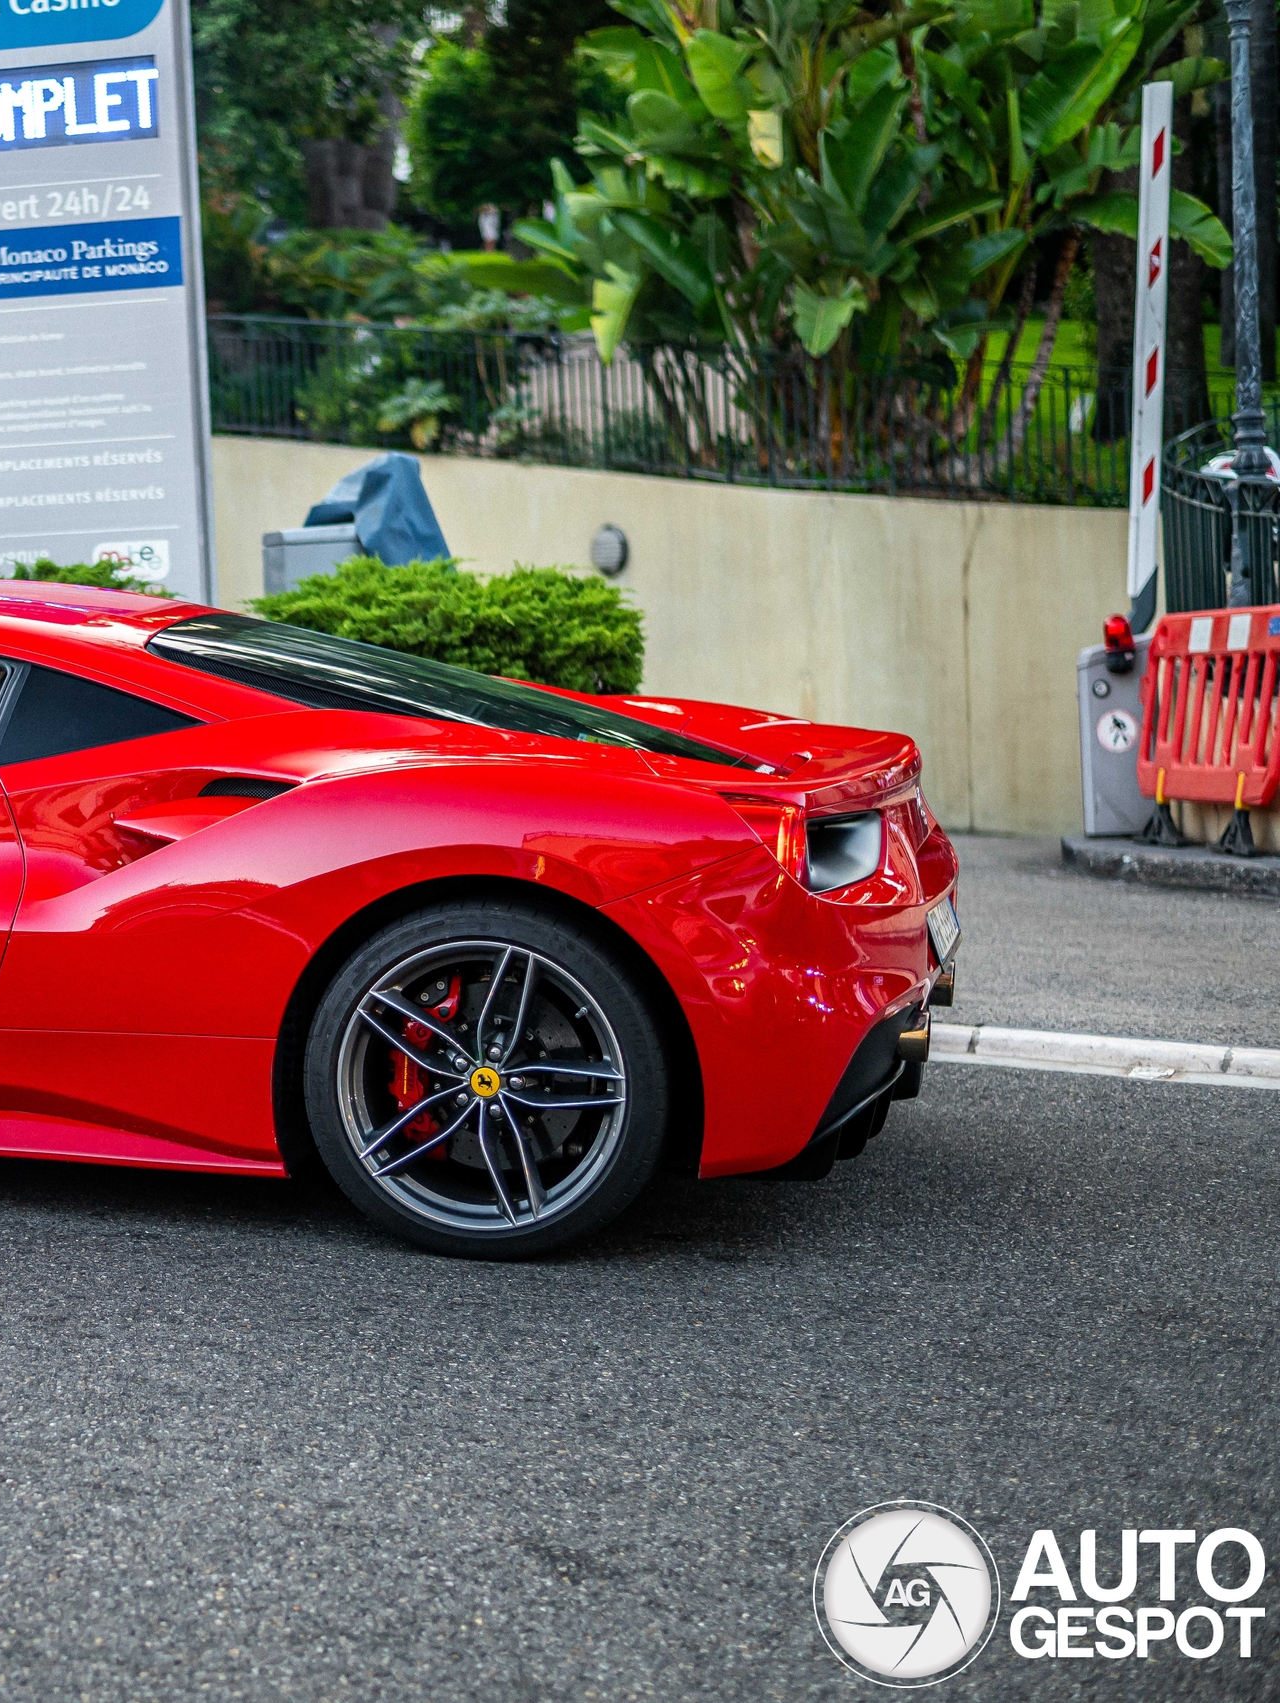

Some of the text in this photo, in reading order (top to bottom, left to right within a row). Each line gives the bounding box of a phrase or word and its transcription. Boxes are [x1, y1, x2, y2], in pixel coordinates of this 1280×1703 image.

[46, 184, 151, 218] 24h/24
[71, 238, 159, 262] Parkings
[82, 265, 102, 279] DE
[104, 260, 170, 276] MONACO
[93, 450, 164, 467] RÉSERVÉS
[94, 485, 166, 503] RÉSERVÉS
